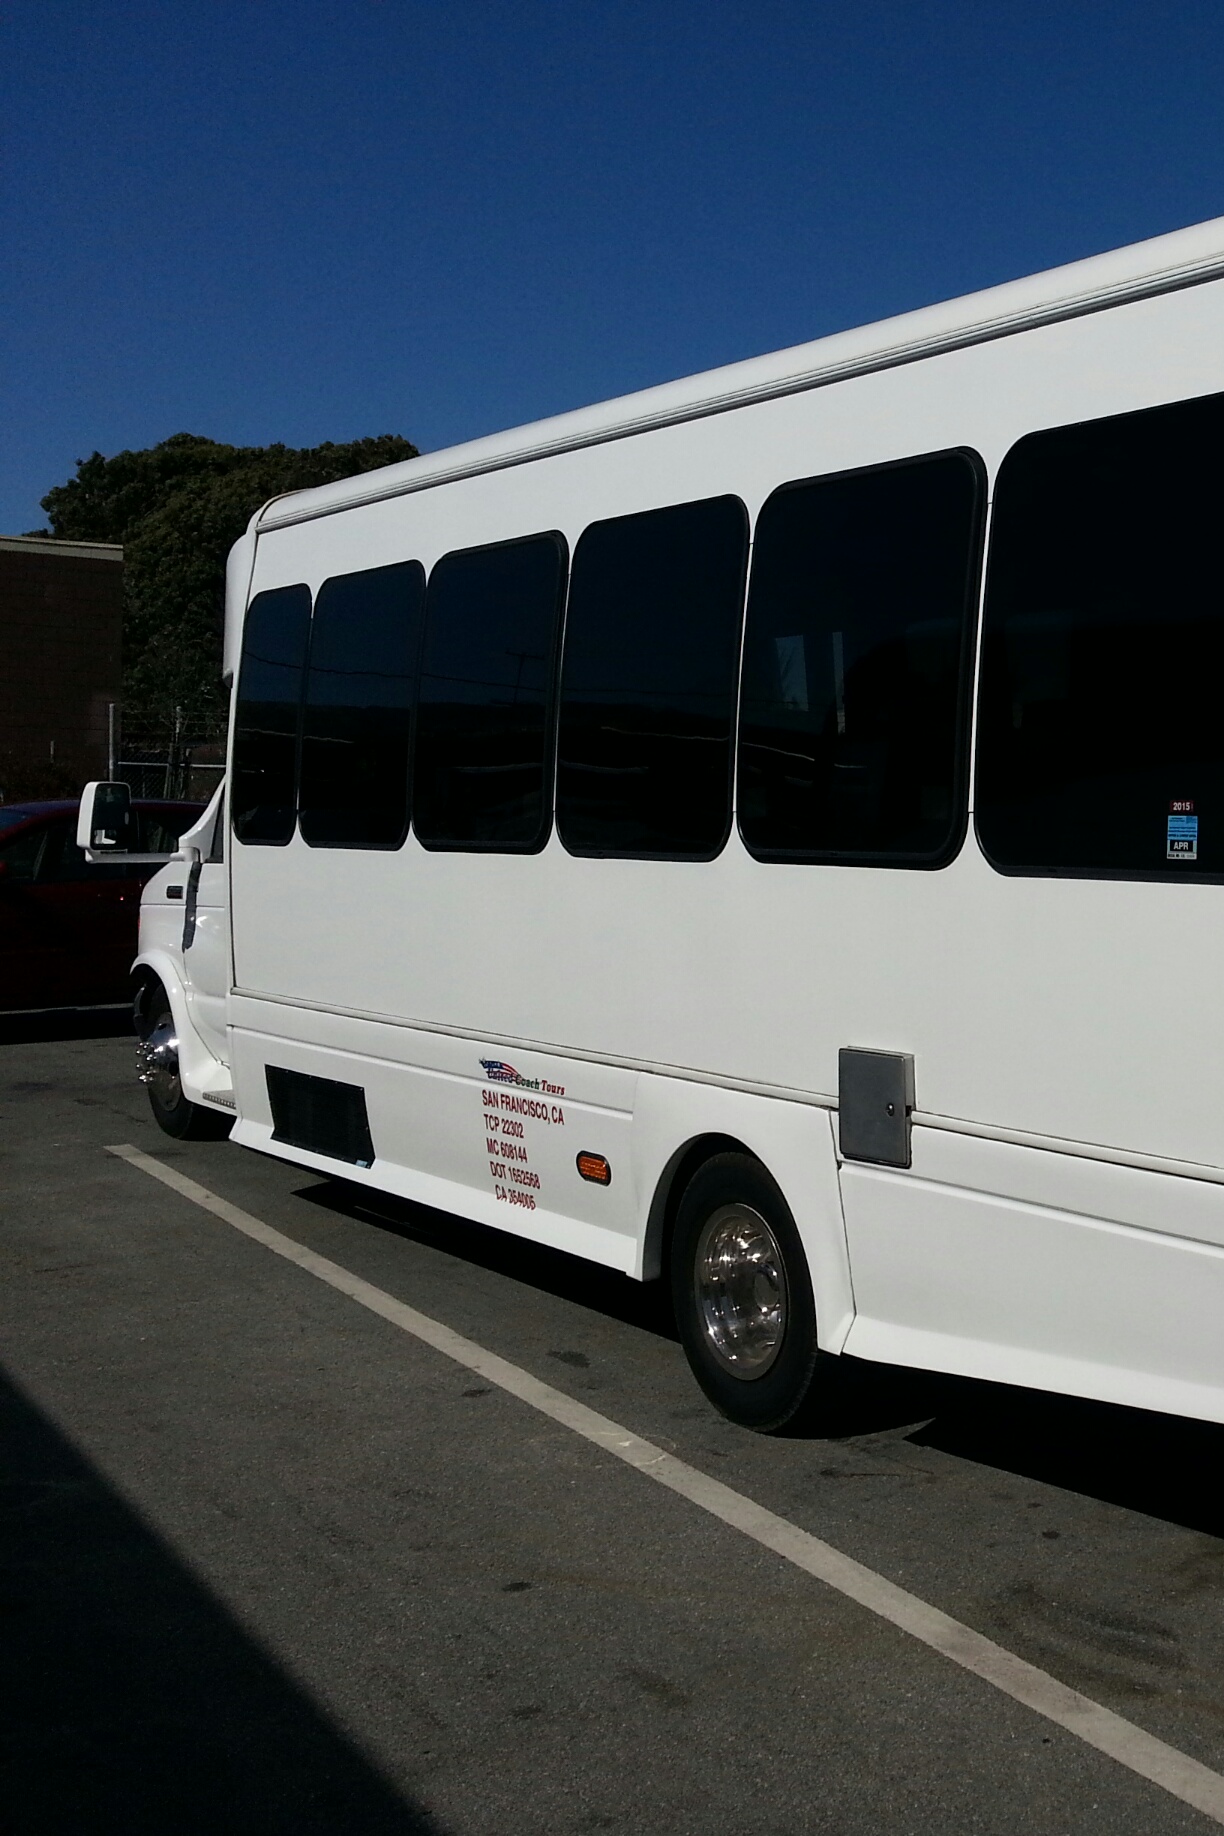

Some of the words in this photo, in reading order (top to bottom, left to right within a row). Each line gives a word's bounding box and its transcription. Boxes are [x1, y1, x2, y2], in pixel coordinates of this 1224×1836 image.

[1173, 802, 1190, 811] 2015
[1173, 841, 1189, 850] APR
[516, 1073, 540, 1090] Coach
[541, 1080, 565, 1096] Tours
[482, 1089, 499, 1109] SAN
[500, 1093, 551, 1125] FRANCISCO,
[551, 1106, 565, 1125] CA
[483, 1113, 500, 1132] TCP
[501, 1118, 525, 1139] 22302
[486, 1137, 500, 1156] MC
[500, 1141, 528, 1163] 608144
[489, 1161, 507, 1180] DOT
[495, 1184, 507, 1203] CA
